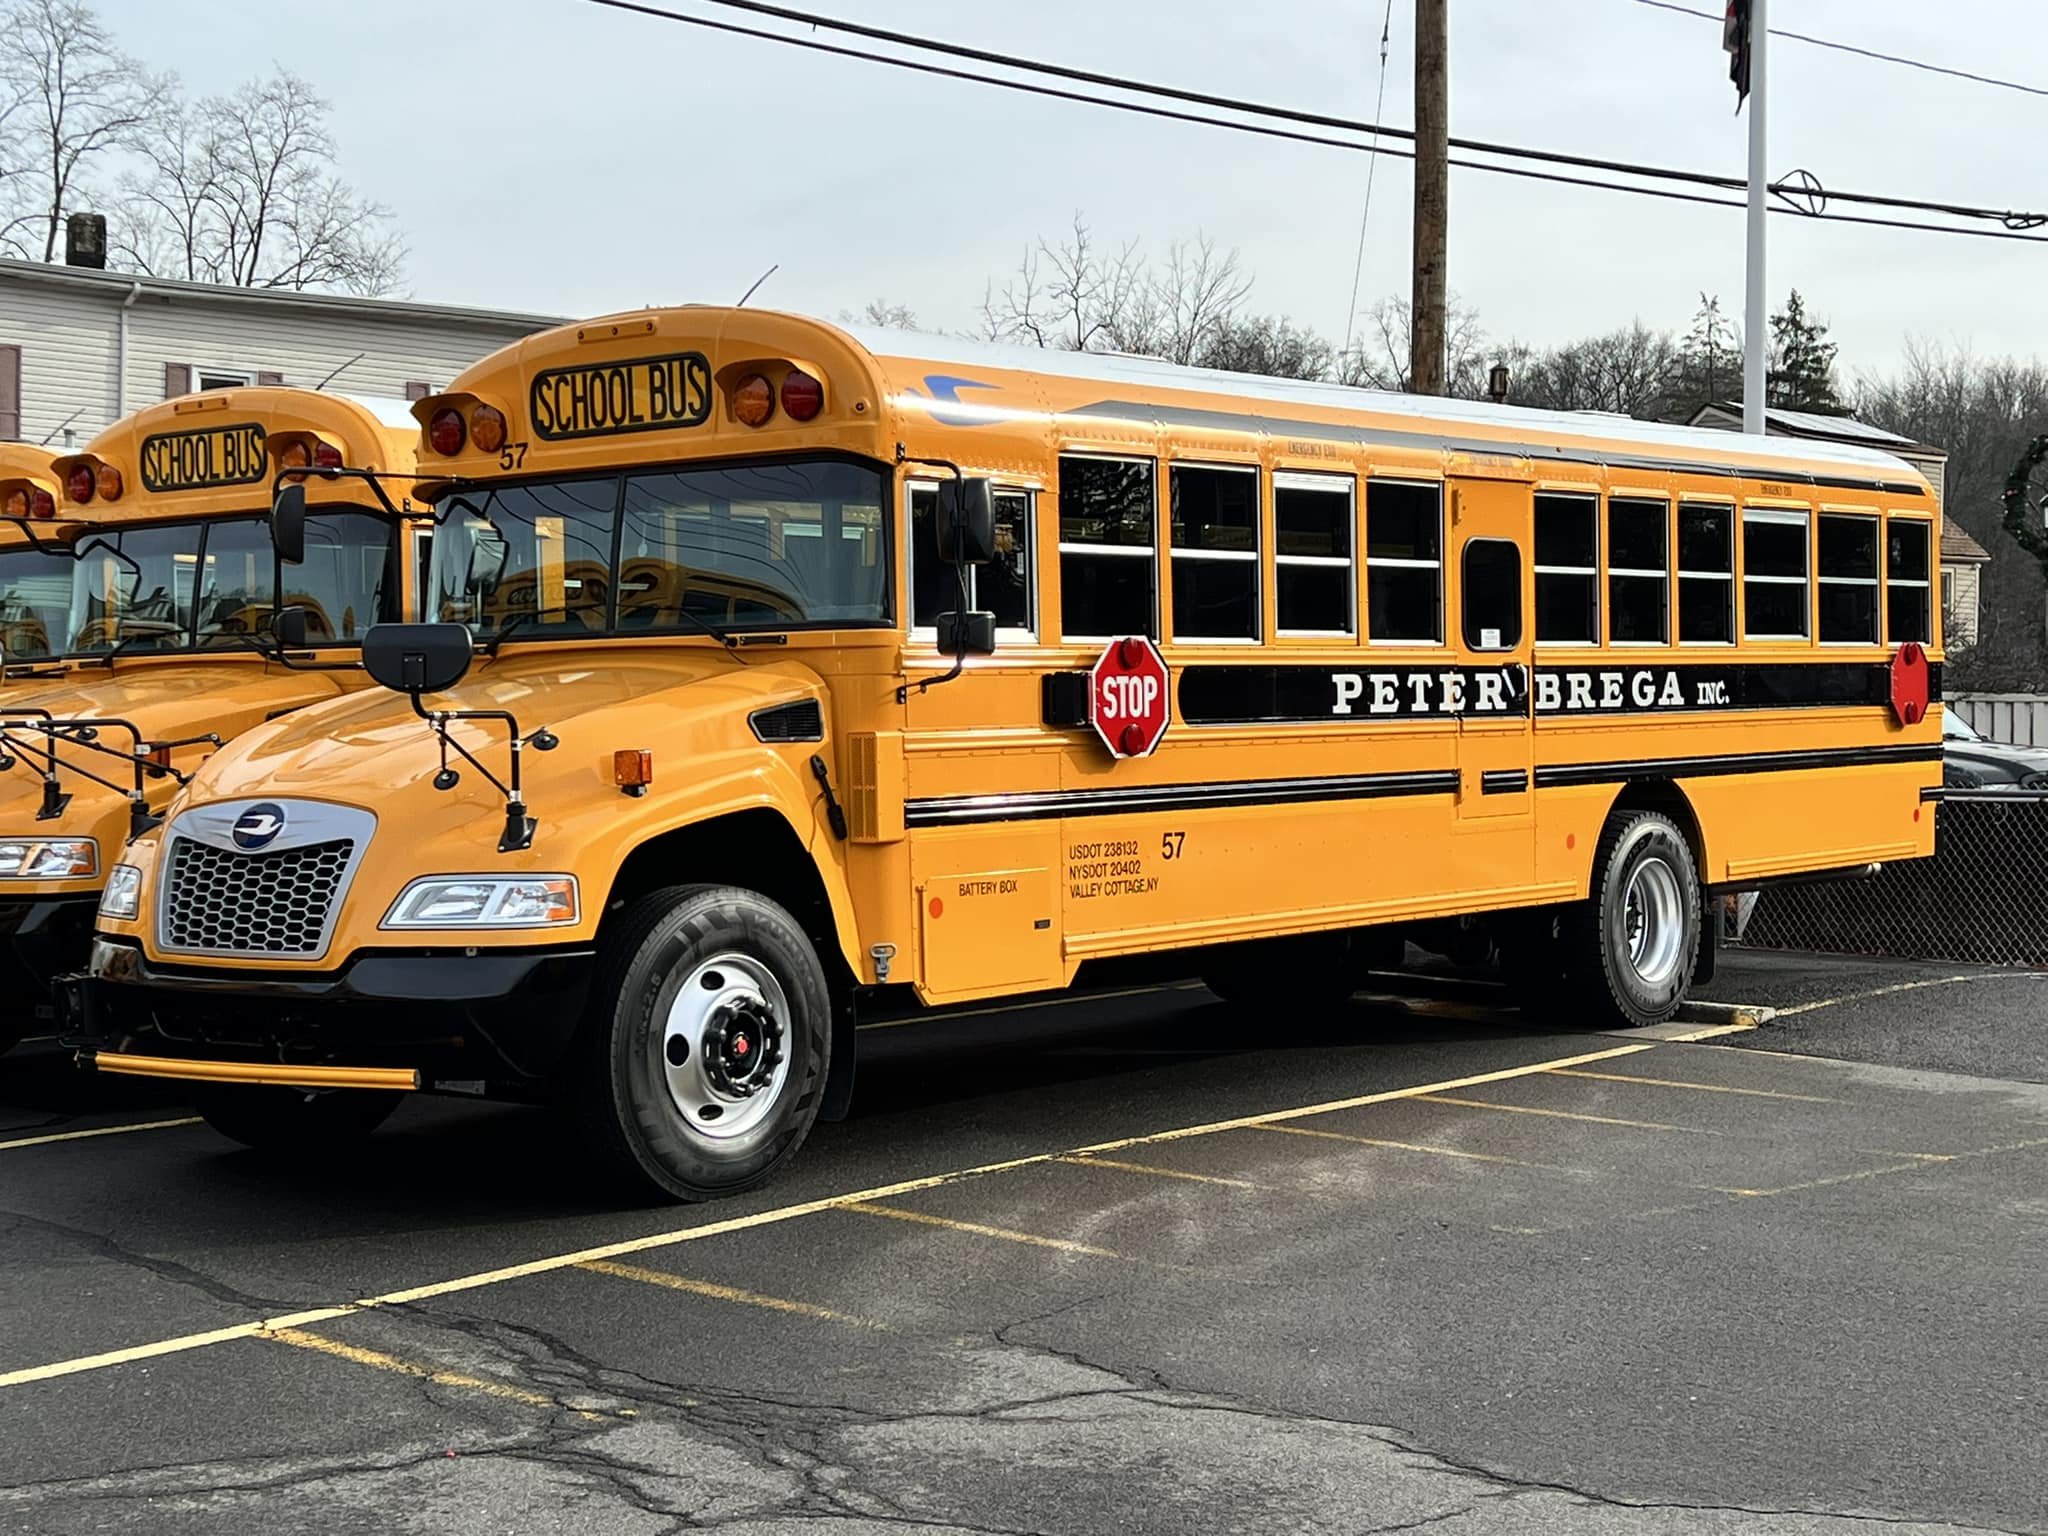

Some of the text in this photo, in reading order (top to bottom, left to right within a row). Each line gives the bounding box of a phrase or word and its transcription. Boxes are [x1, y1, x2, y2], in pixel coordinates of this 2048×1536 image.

[538, 358, 706, 432] SCHOOL BUS
[145, 429, 263, 486] SCHOOL BUS
[499, 442, 528, 471] 57
[1102, 675, 1158, 719] STOP
[1331, 671, 1730, 714] PETER BREGA INC.
[1069, 840, 1139, 860] USDOT 238132
[1162, 831, 1186, 860] 57
[1069, 860, 1141, 880] NYSDOT 20402
[959, 879, 1018, 897] BATTERY BOX
[1070, 882, 1102, 899] VALLEY
